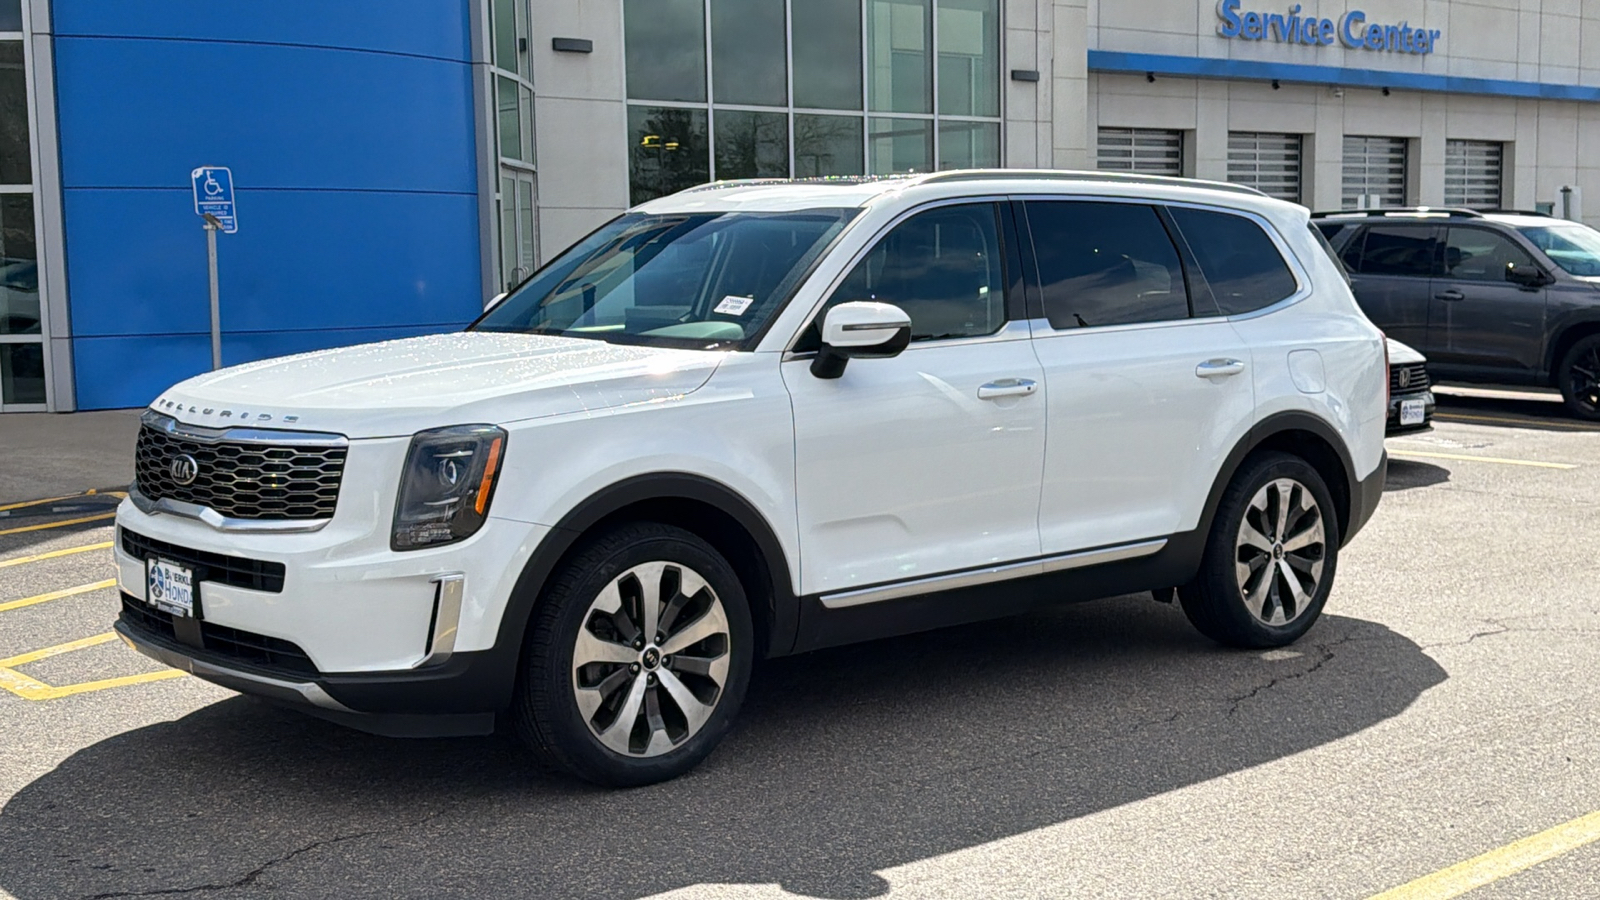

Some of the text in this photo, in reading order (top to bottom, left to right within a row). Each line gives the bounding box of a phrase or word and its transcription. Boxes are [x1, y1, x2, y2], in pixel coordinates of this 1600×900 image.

[1217, 0, 1441, 54] Service Center
[159, 398, 299, 423] TELLURIDE
[172, 460, 190, 478] KIA
